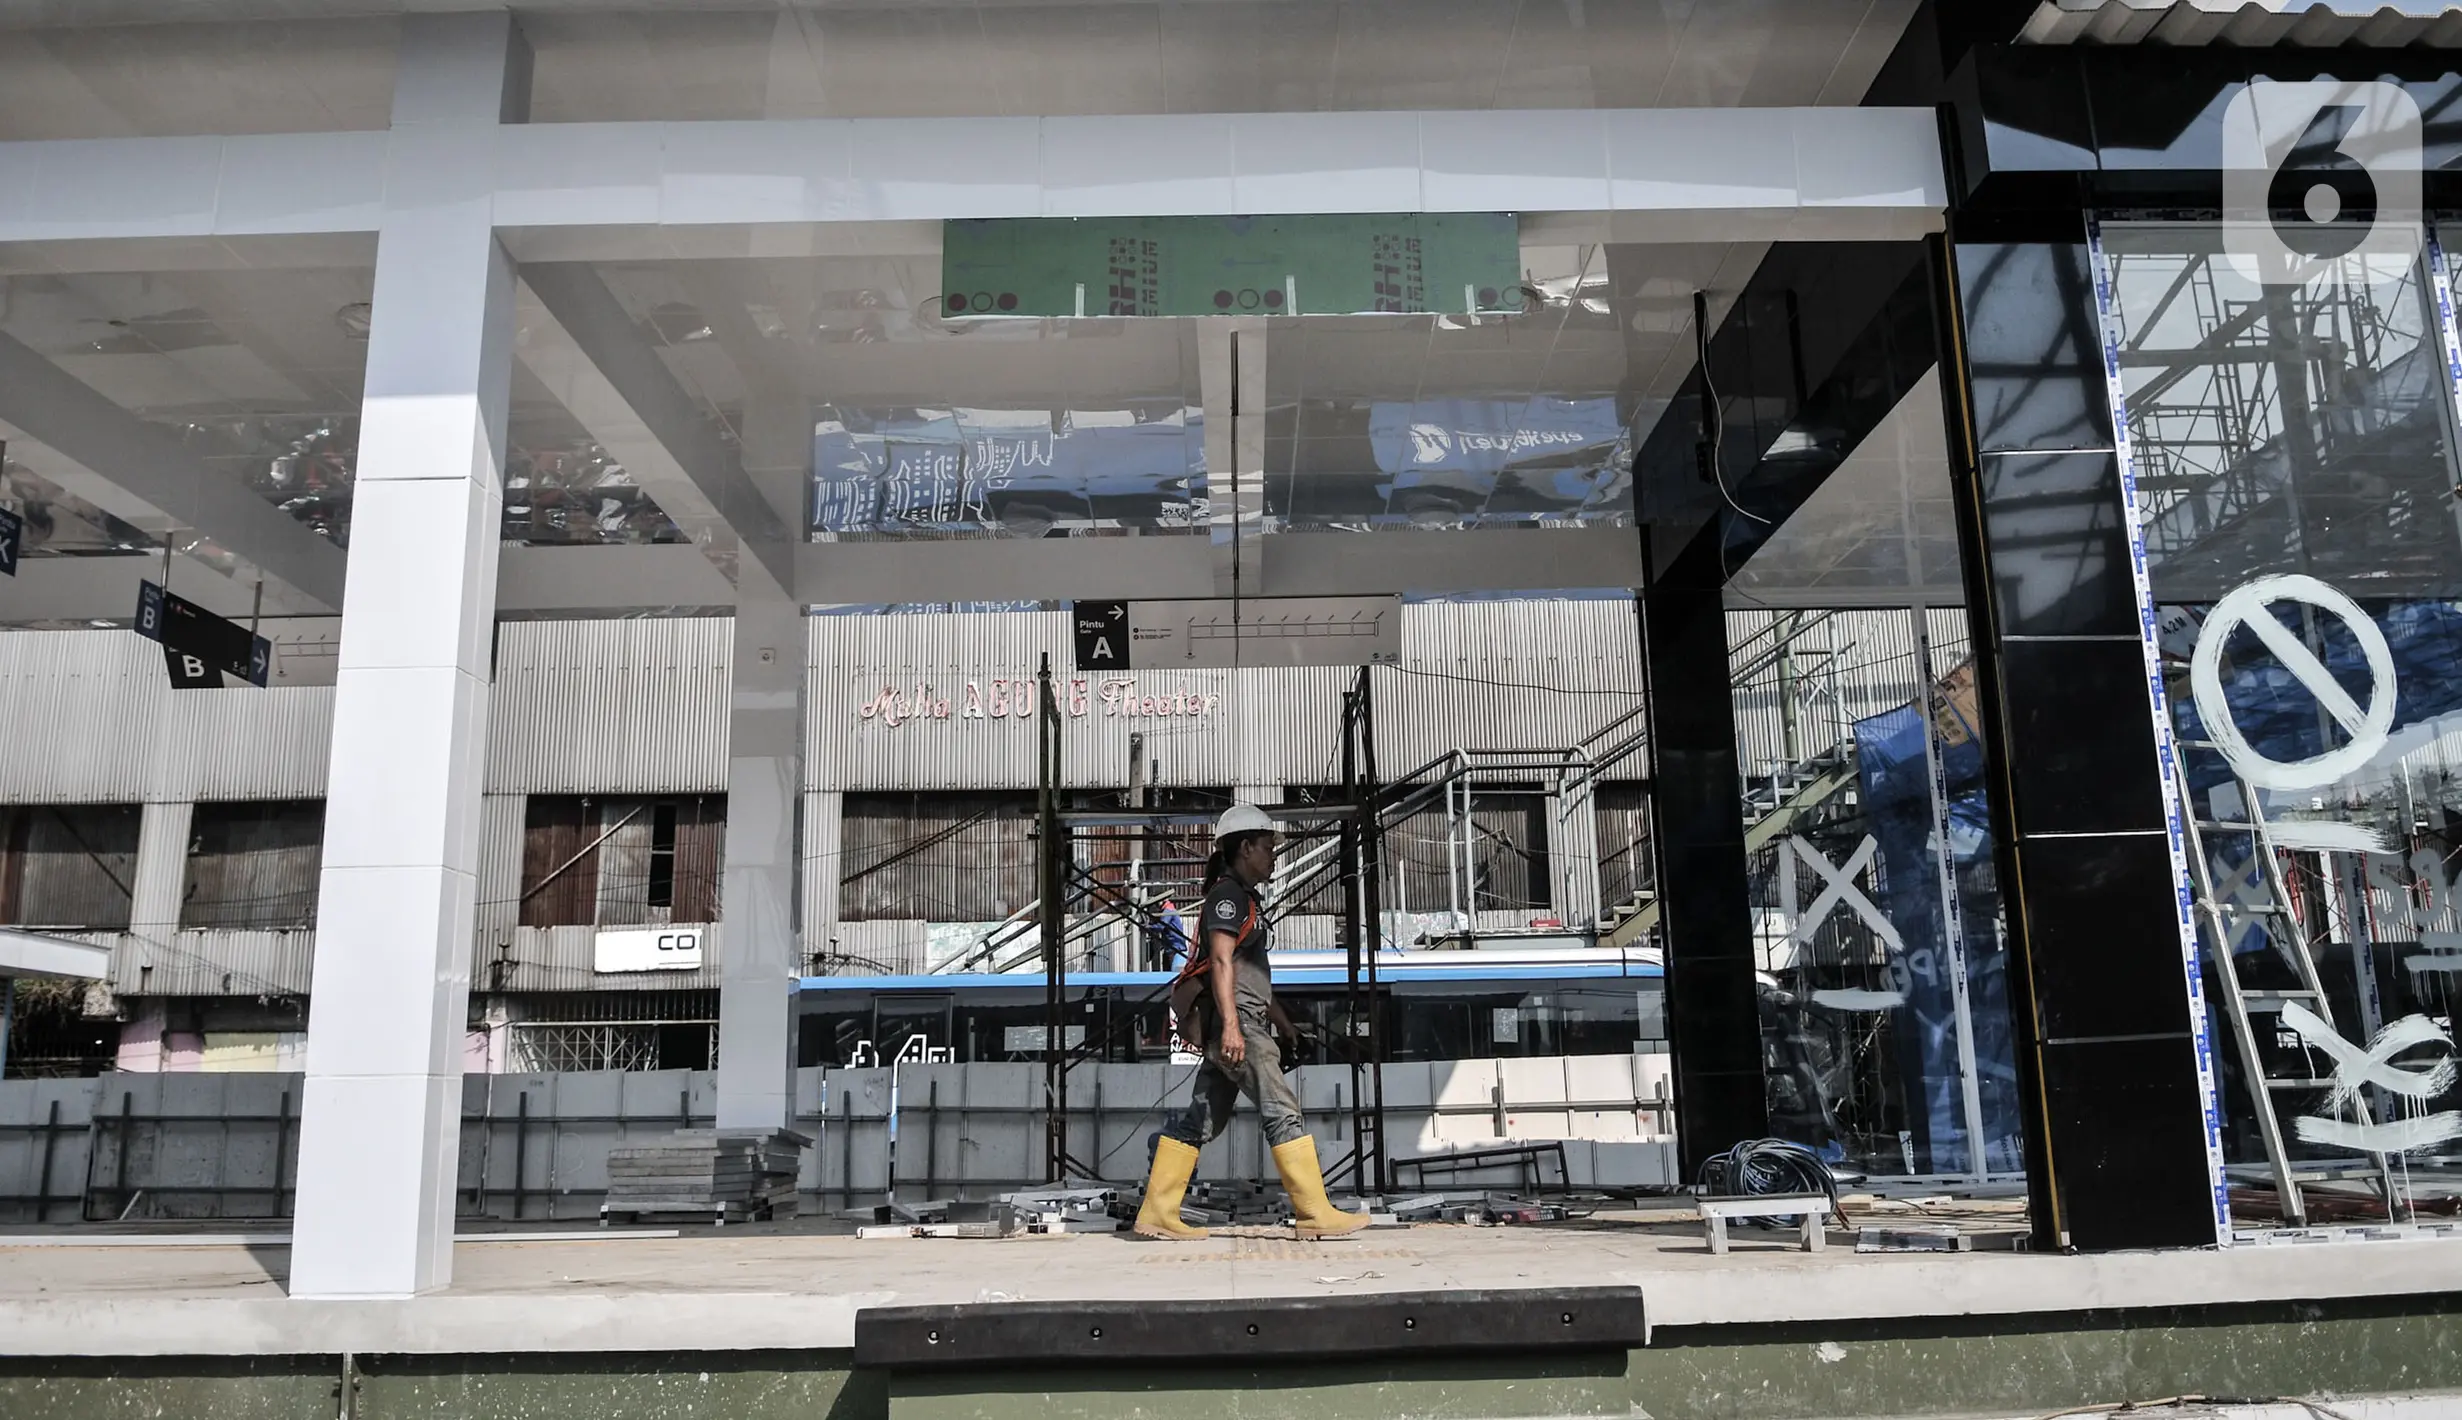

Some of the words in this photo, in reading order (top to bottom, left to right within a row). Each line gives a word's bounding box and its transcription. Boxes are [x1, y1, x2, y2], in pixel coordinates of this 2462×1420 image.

[143, 605, 155, 630] B
[1080, 620, 1105, 629] Pintu
[1092, 636, 1114, 659] A
[182, 654, 205, 678] B
[1098, 678, 1219, 717] Theater
